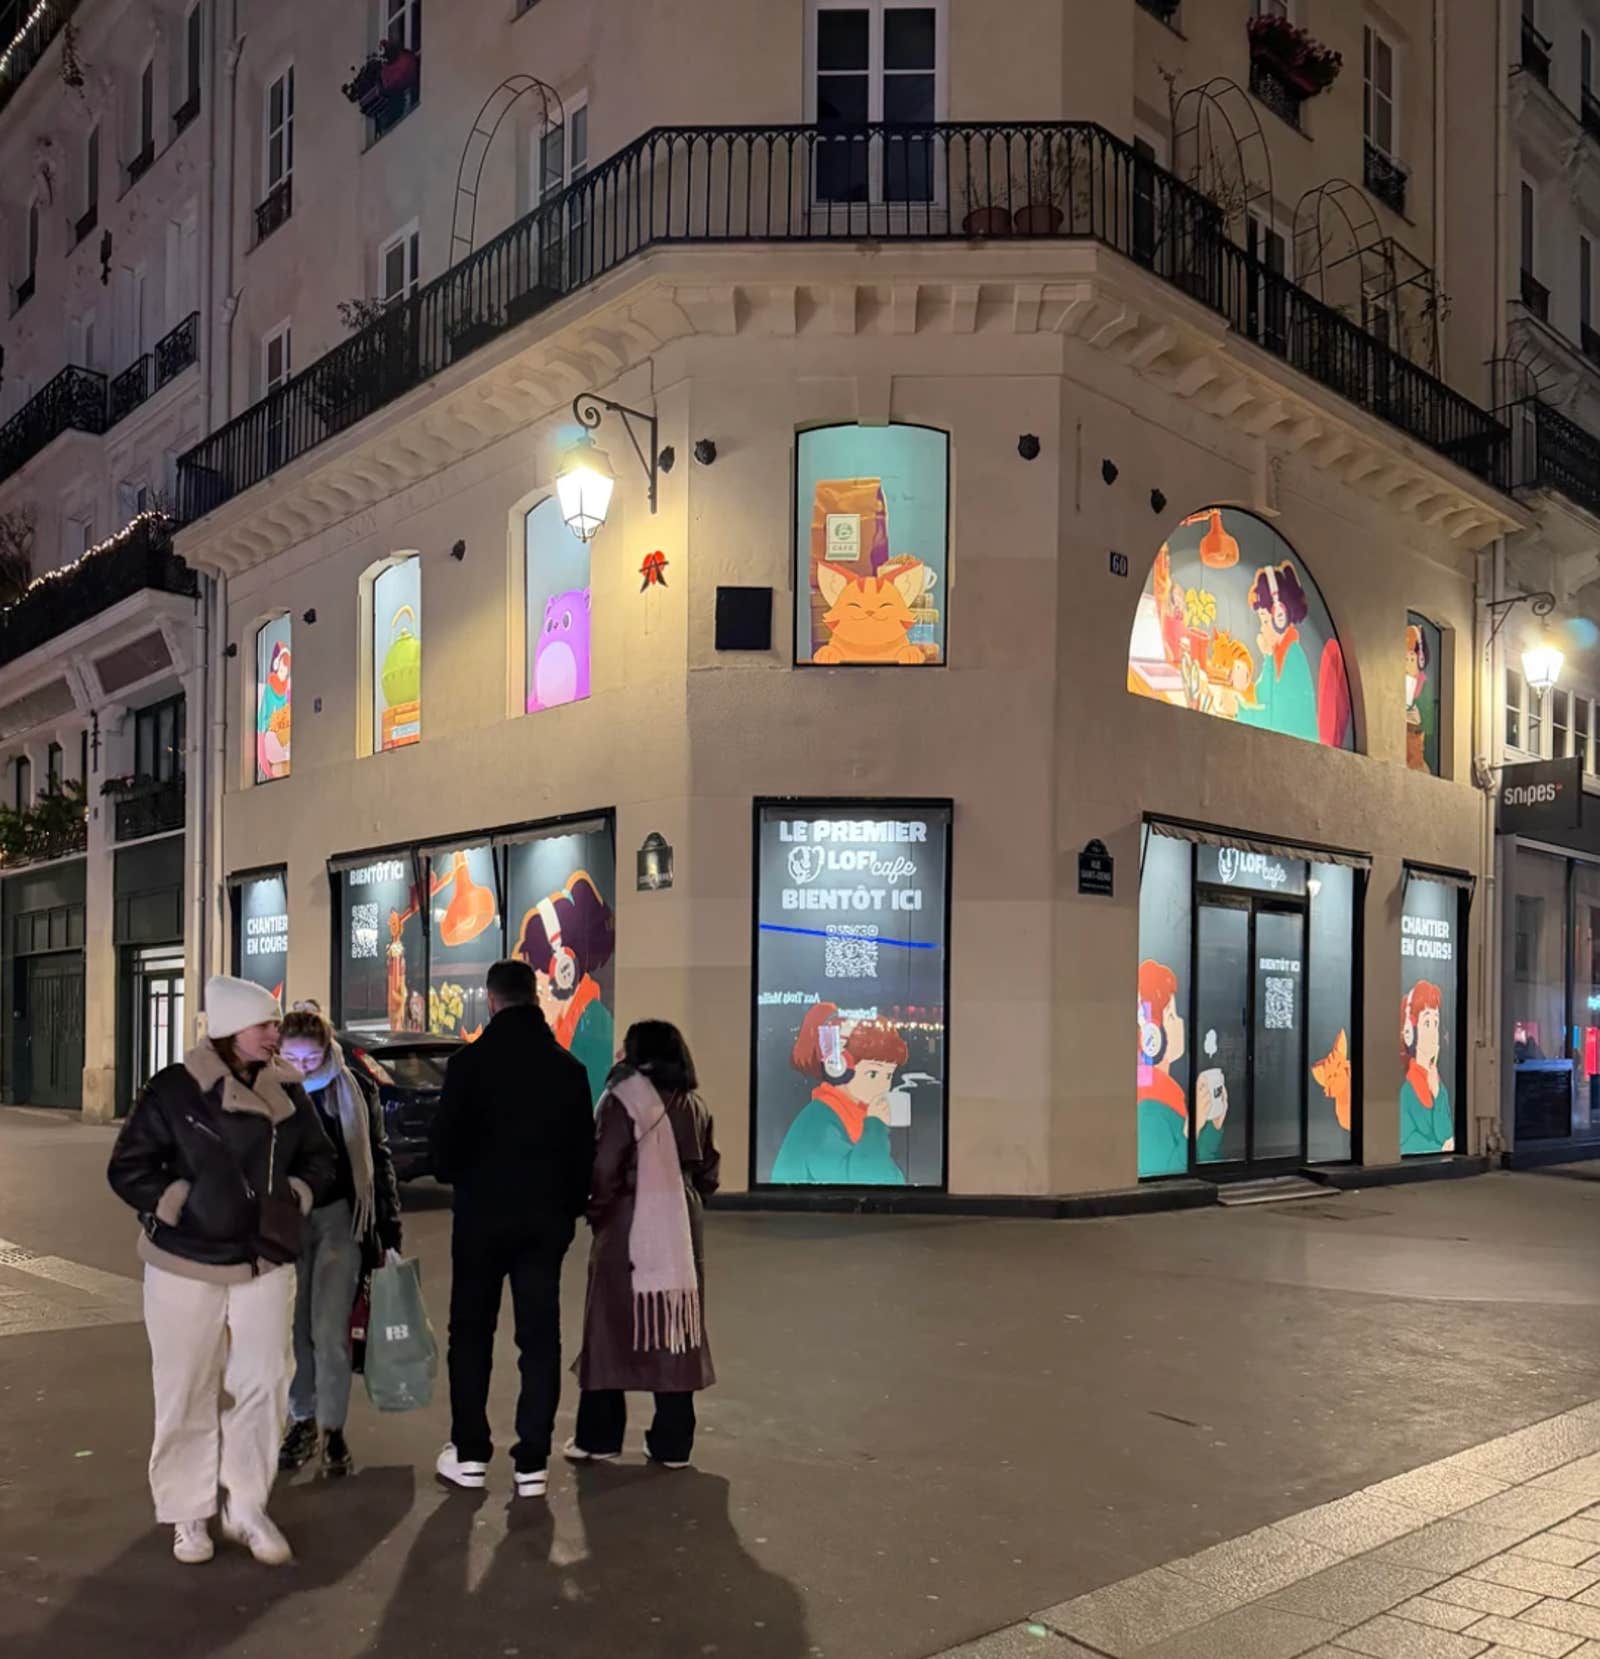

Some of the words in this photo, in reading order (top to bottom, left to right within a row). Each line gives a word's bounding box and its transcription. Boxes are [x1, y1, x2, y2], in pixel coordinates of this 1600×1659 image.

[1112, 555, 1127, 574] 60
[1504, 783, 1556, 806] snipes
[779, 821, 808, 842] LE
[813, 820, 927, 842] PREMIER
[782, 885, 886, 910] BIENTÔT
[891, 889, 923, 910] ICI
[1401, 915, 1450, 939] CHANTIER
[247, 938, 259, 955] EN
[1401, 937, 1415, 956] EN
[1416, 939, 1452, 960] COURS!
